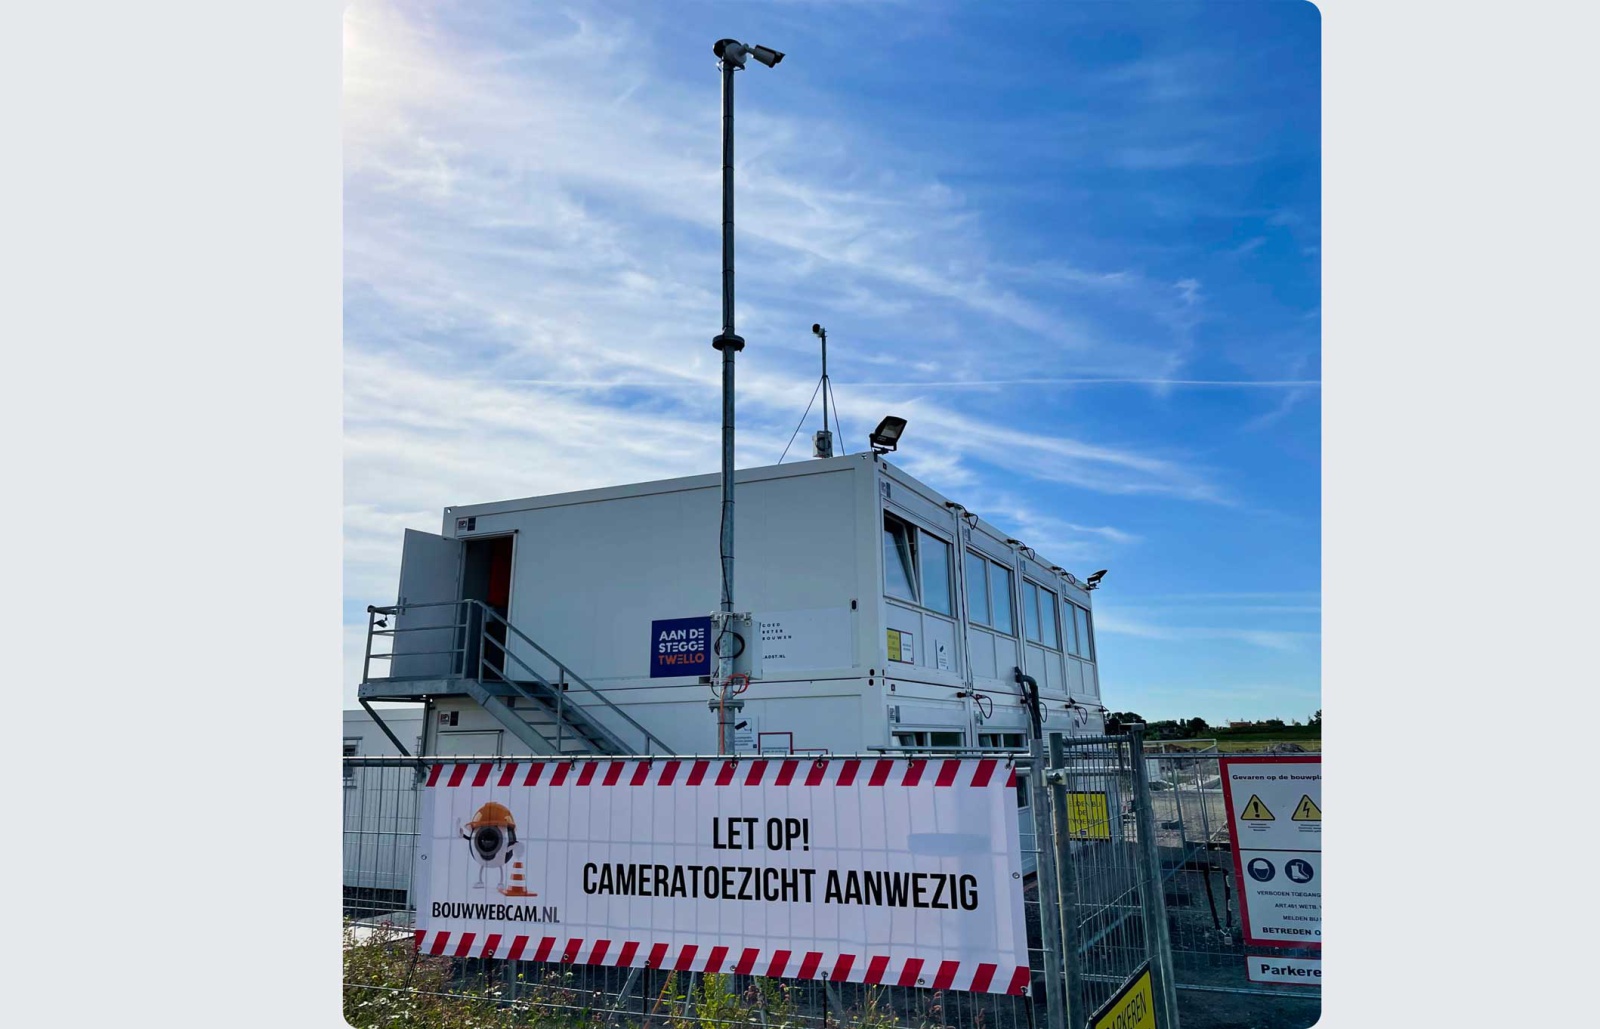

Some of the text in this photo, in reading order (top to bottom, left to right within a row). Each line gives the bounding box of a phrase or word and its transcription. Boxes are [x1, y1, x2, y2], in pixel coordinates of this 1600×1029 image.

[659, 628, 705, 641] AAN DE
[658, 640, 705, 653] STEGGE
[658, 652, 705, 666] TWELLO
[712, 817, 810, 851] LET OP!
[583, 862, 979, 911] CAMERATOEZICHT AANWEZIG
[432, 901, 560, 923] BOUWWEBCAM.NL
[1262, 926, 1312, 936] BETREDEN
[1261, 964, 1322, 977] Parkere
